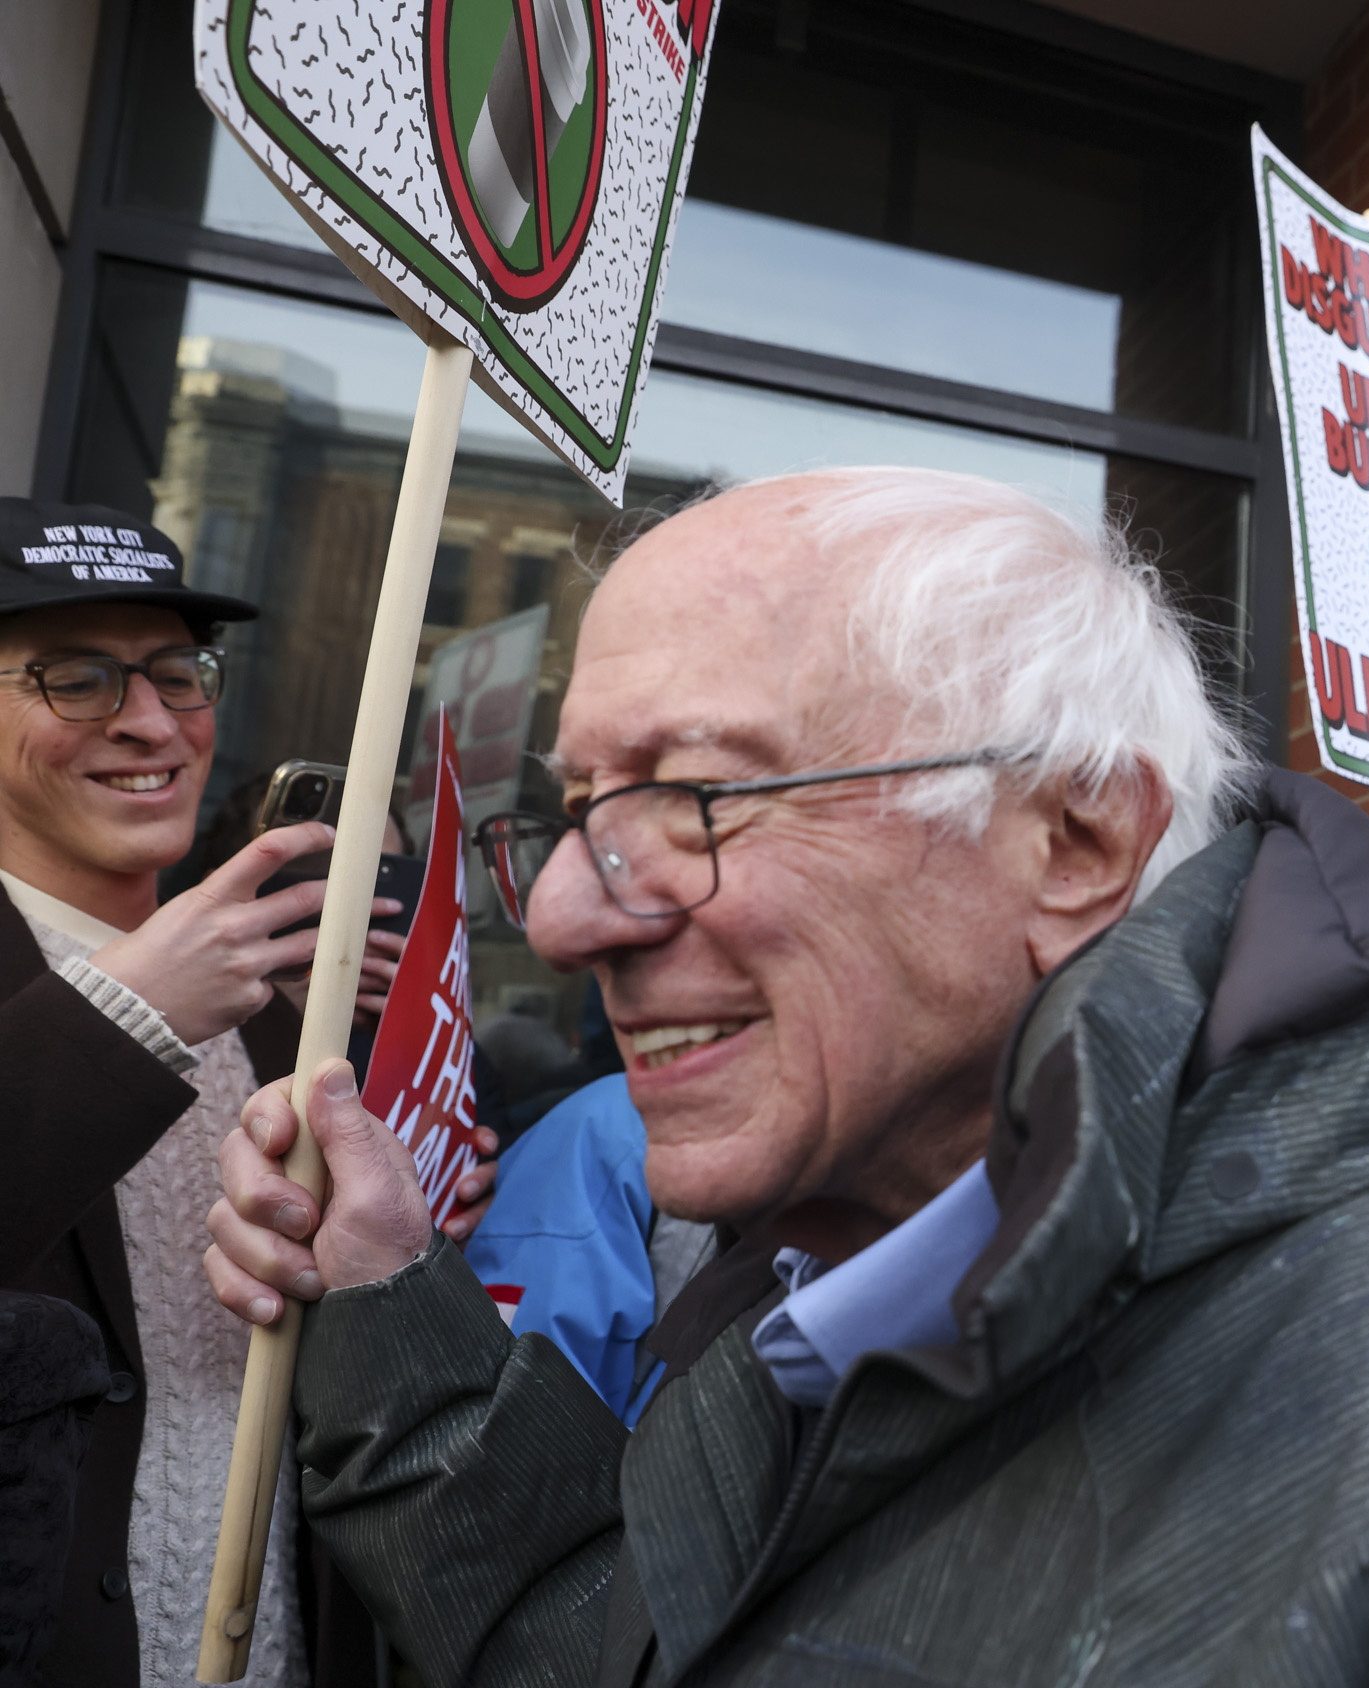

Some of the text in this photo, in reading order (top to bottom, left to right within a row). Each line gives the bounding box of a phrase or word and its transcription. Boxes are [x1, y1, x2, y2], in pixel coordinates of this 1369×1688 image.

[43, 525, 144, 548] NEW YORK CITY
[21, 545, 175, 570] DEMOCRATIC SOCIALISTS
[71, 565, 153, 582] OF AMERICA
[412, 992, 477, 1129] THE
